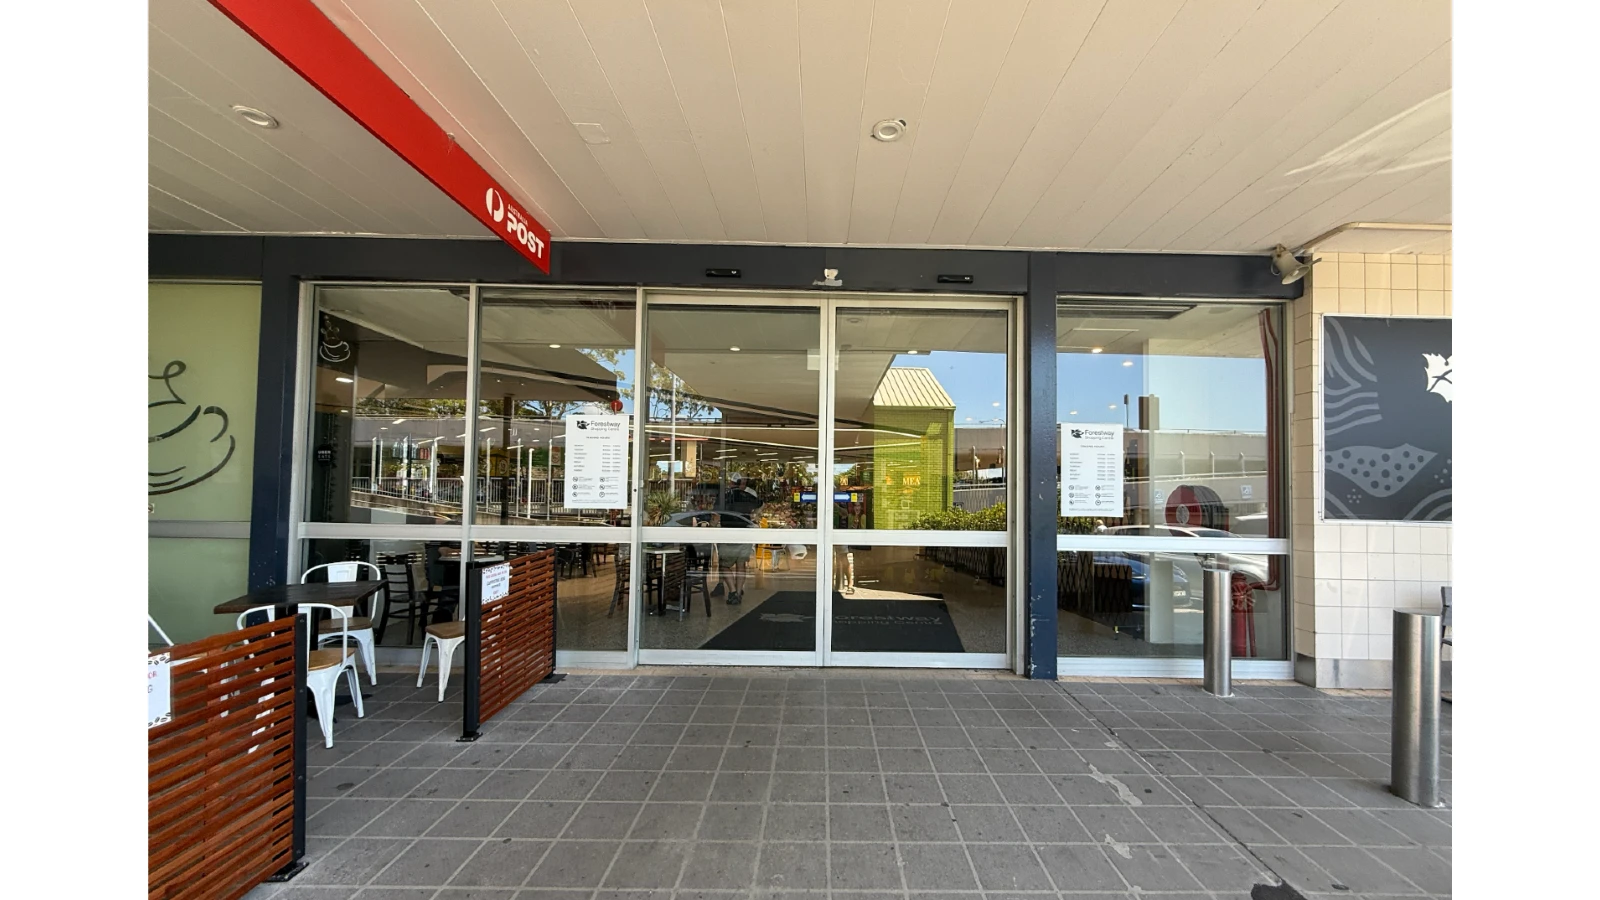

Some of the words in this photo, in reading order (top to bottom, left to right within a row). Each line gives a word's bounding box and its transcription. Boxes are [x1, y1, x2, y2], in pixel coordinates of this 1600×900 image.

[507, 203, 529, 227] AUSTRALIA
[507, 211, 545, 259] POST
[590, 420, 621, 428] Forestway
[1085, 429, 1115, 437] Forestway
